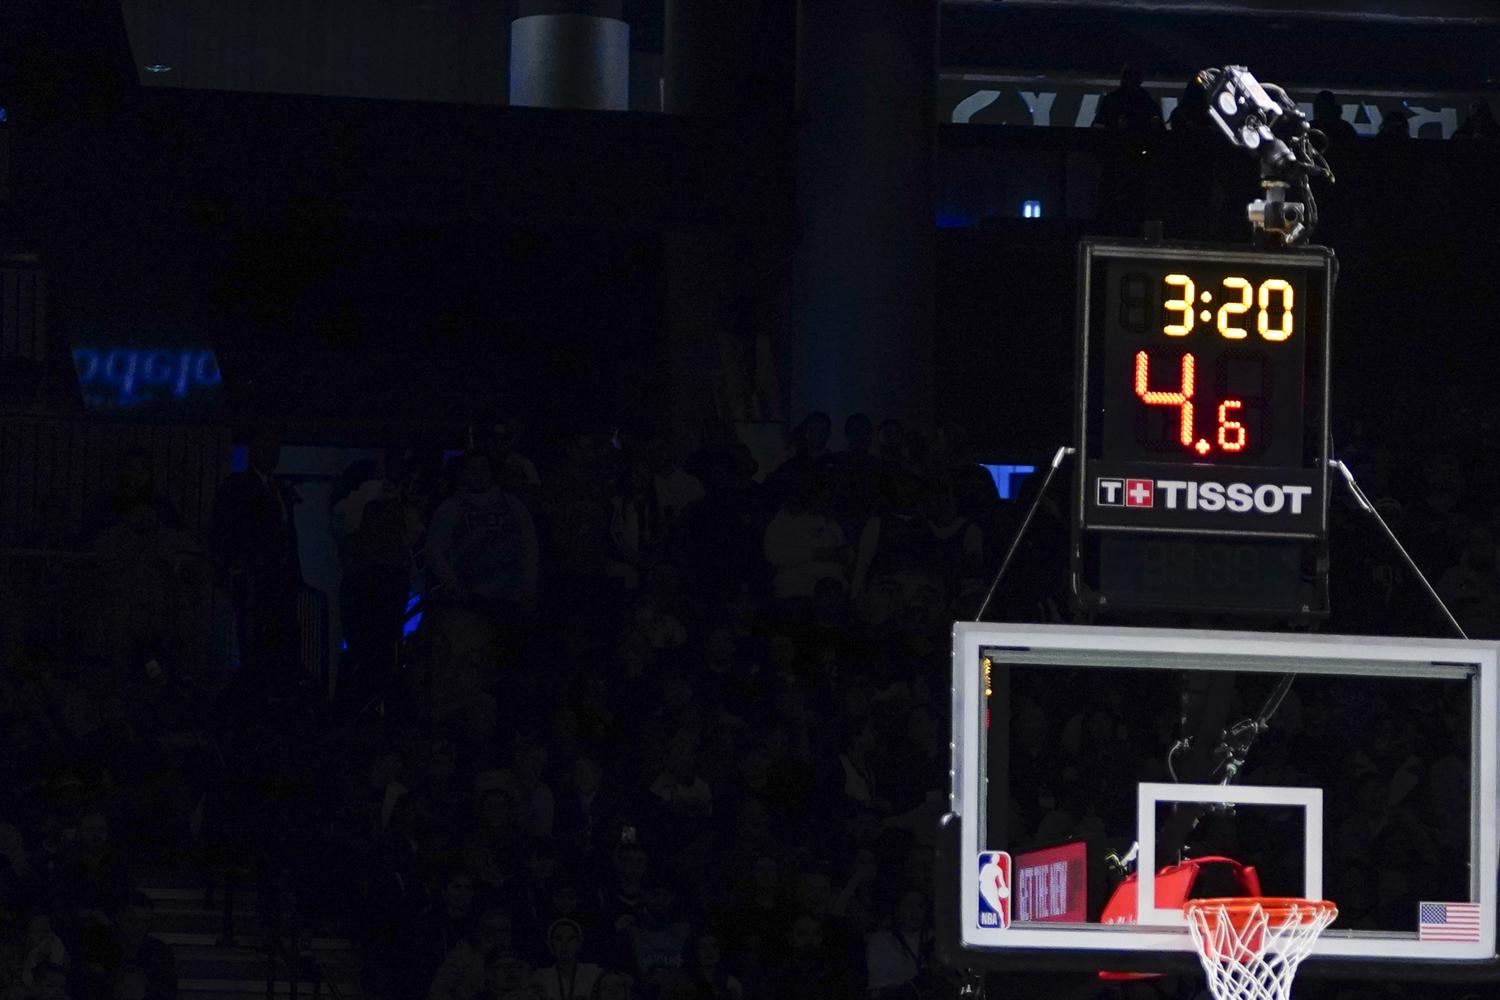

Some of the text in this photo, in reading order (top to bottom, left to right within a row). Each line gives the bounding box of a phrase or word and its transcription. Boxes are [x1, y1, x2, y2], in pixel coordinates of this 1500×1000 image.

[1164, 273, 1294, 341] 3:20
[1135, 350, 1247, 455] 4.6
[1157, 479, 1312, 514] TISSOT
[981, 913, 998, 926] NBA
